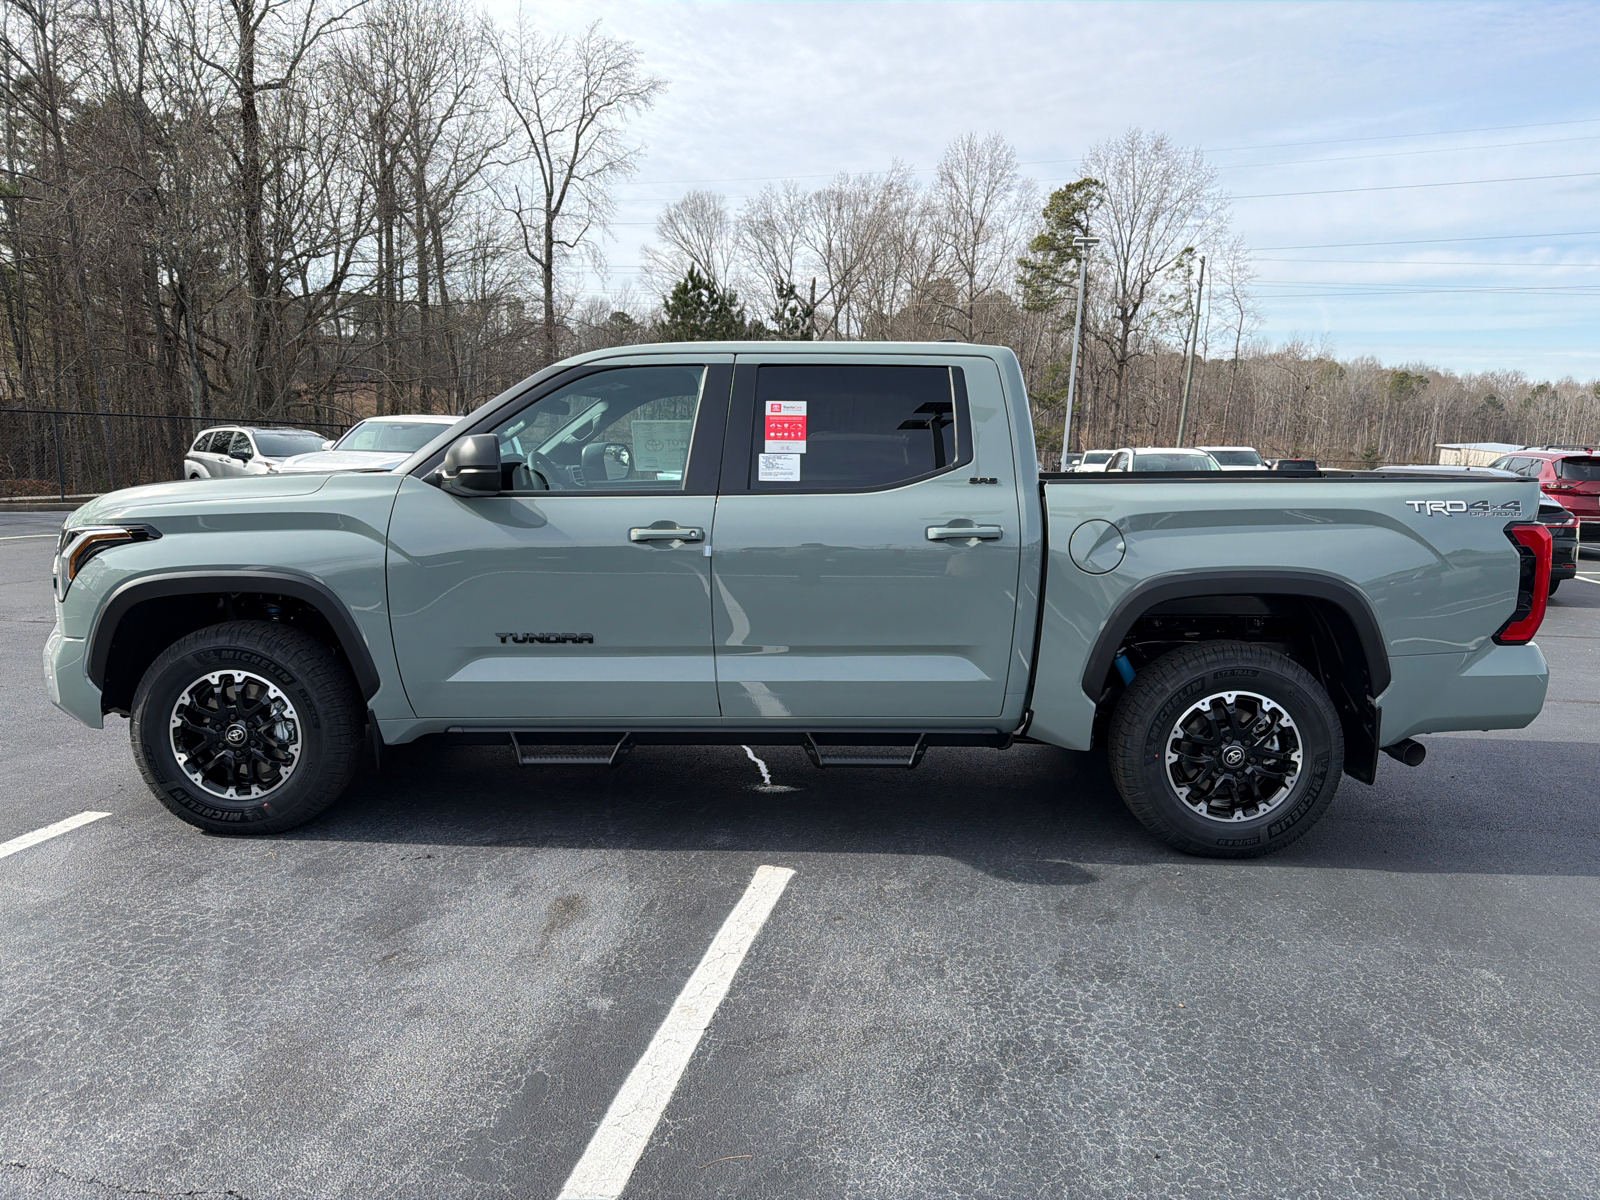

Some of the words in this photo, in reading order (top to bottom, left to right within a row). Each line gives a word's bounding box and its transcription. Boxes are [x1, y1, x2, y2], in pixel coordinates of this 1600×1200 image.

[1405, 500, 1469, 517] TRD
[1469, 500, 1522, 513] 4x4
[495, 632, 595, 644] TUNDRA
[220, 650, 294, 686] MICHELIN
[1149, 679, 1203, 741] MICHELIN
[170, 787, 242, 821] MICHELIN
[1270, 776, 1323, 836] MICHELIN
